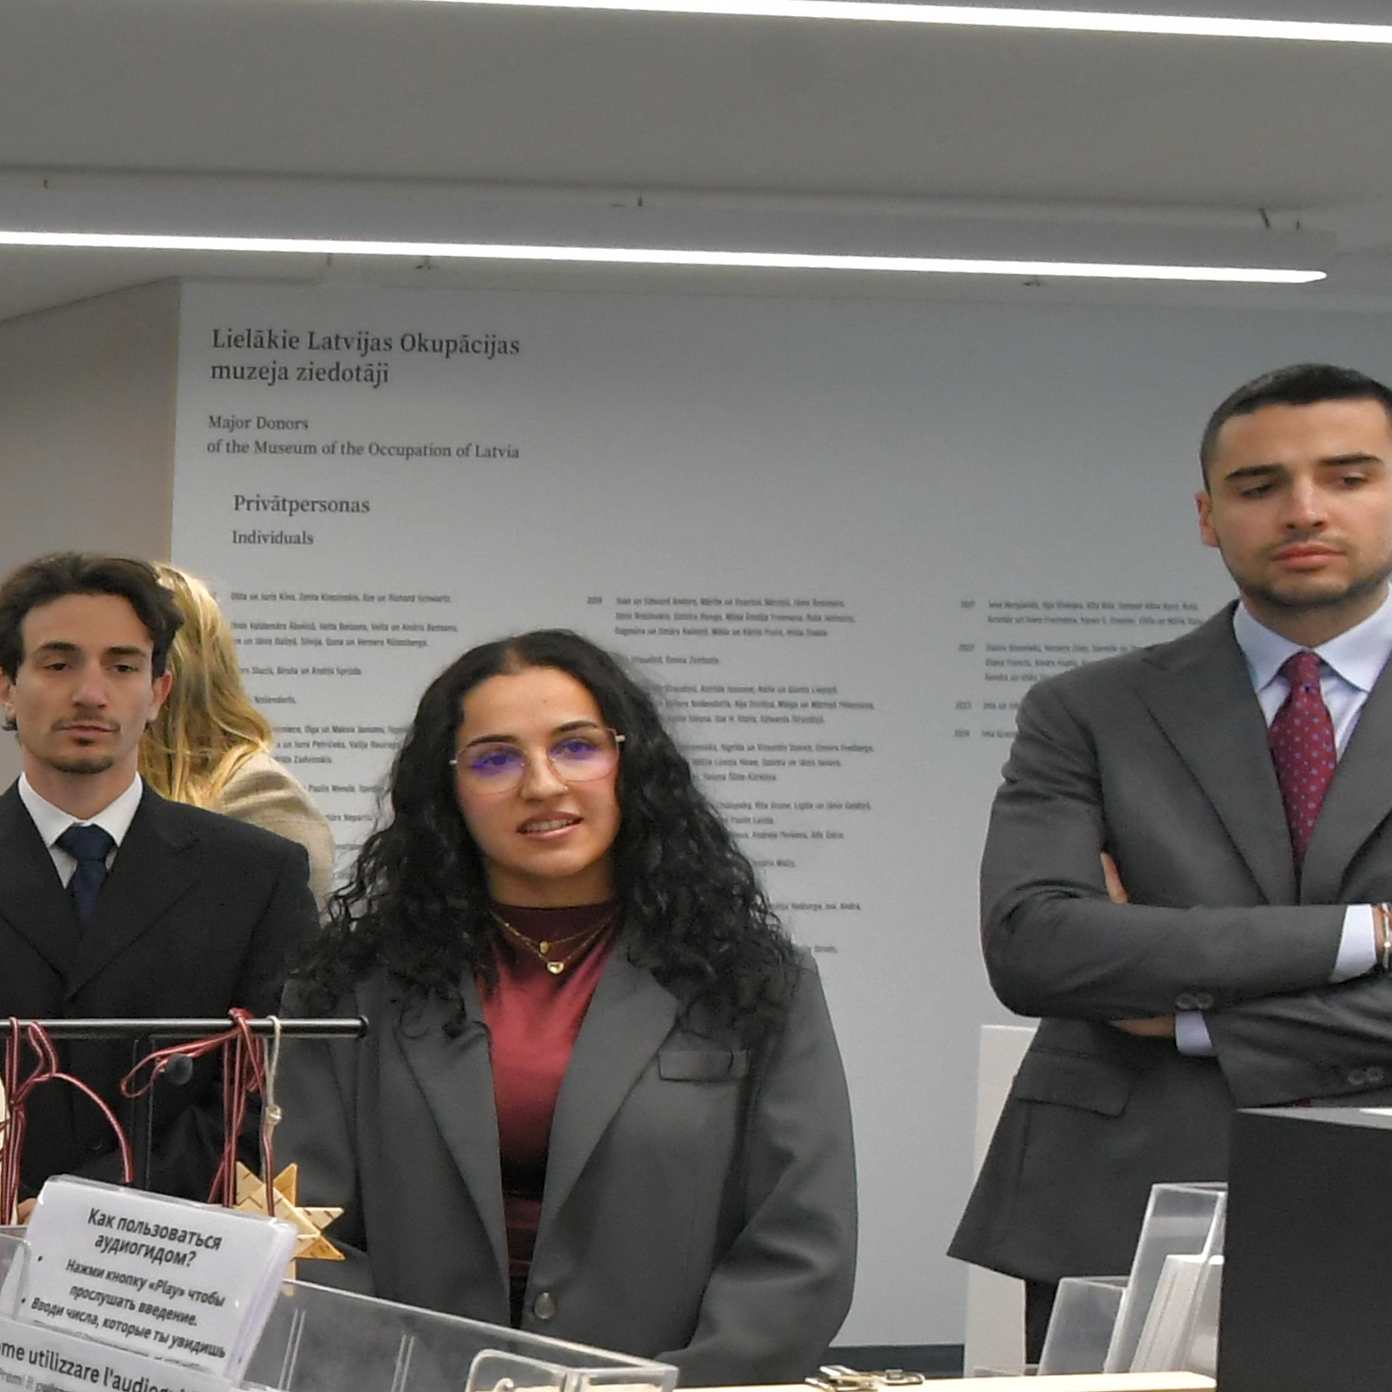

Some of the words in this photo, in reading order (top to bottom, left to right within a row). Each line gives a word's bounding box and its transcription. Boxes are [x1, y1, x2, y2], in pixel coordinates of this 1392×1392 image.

[212, 329, 300, 352] Lielākie
[307, 331, 393, 357] Latvijas
[400, 333, 520, 359] Okupācijas
[211, 363, 289, 386] muzeja
[296, 361, 389, 387] ziedotāji
[208, 415, 251, 432] Major
[256, 416, 309, 430] Donors
[207, 439, 223, 454] of
[225, 440, 250, 455] the
[254, 441, 317, 455] Museum
[321, 441, 338, 456] of
[340, 441, 365, 456] the
[368, 442, 452, 461] Occupation
[455, 443, 472, 458] of
[475, 444, 520, 459] Latvia
[233, 495, 371, 517] Privātpersonas
[231, 530, 315, 545] Individuals
[87, 1210, 116, 1229] Как
[116, 1217, 222, 1250] пользоваться
[94, 1235, 197, 1267] аудиогидом?
[65, 1259, 105, 1278] Нажми
[105, 1271, 148, 1292] кнопку
[148, 1279, 185, 1300] «Play»
[188, 1289, 226, 1307] чтобы
[69, 1286, 136, 1311] прослушать
[31, 1297, 65, 1317] Вводи
[102, 1318, 152, 1339] которые
[153, 1330, 169, 1344] ты
[168, 1335, 226, 1358] увидишь
[28, 1349, 100, 1384] utilizzare
